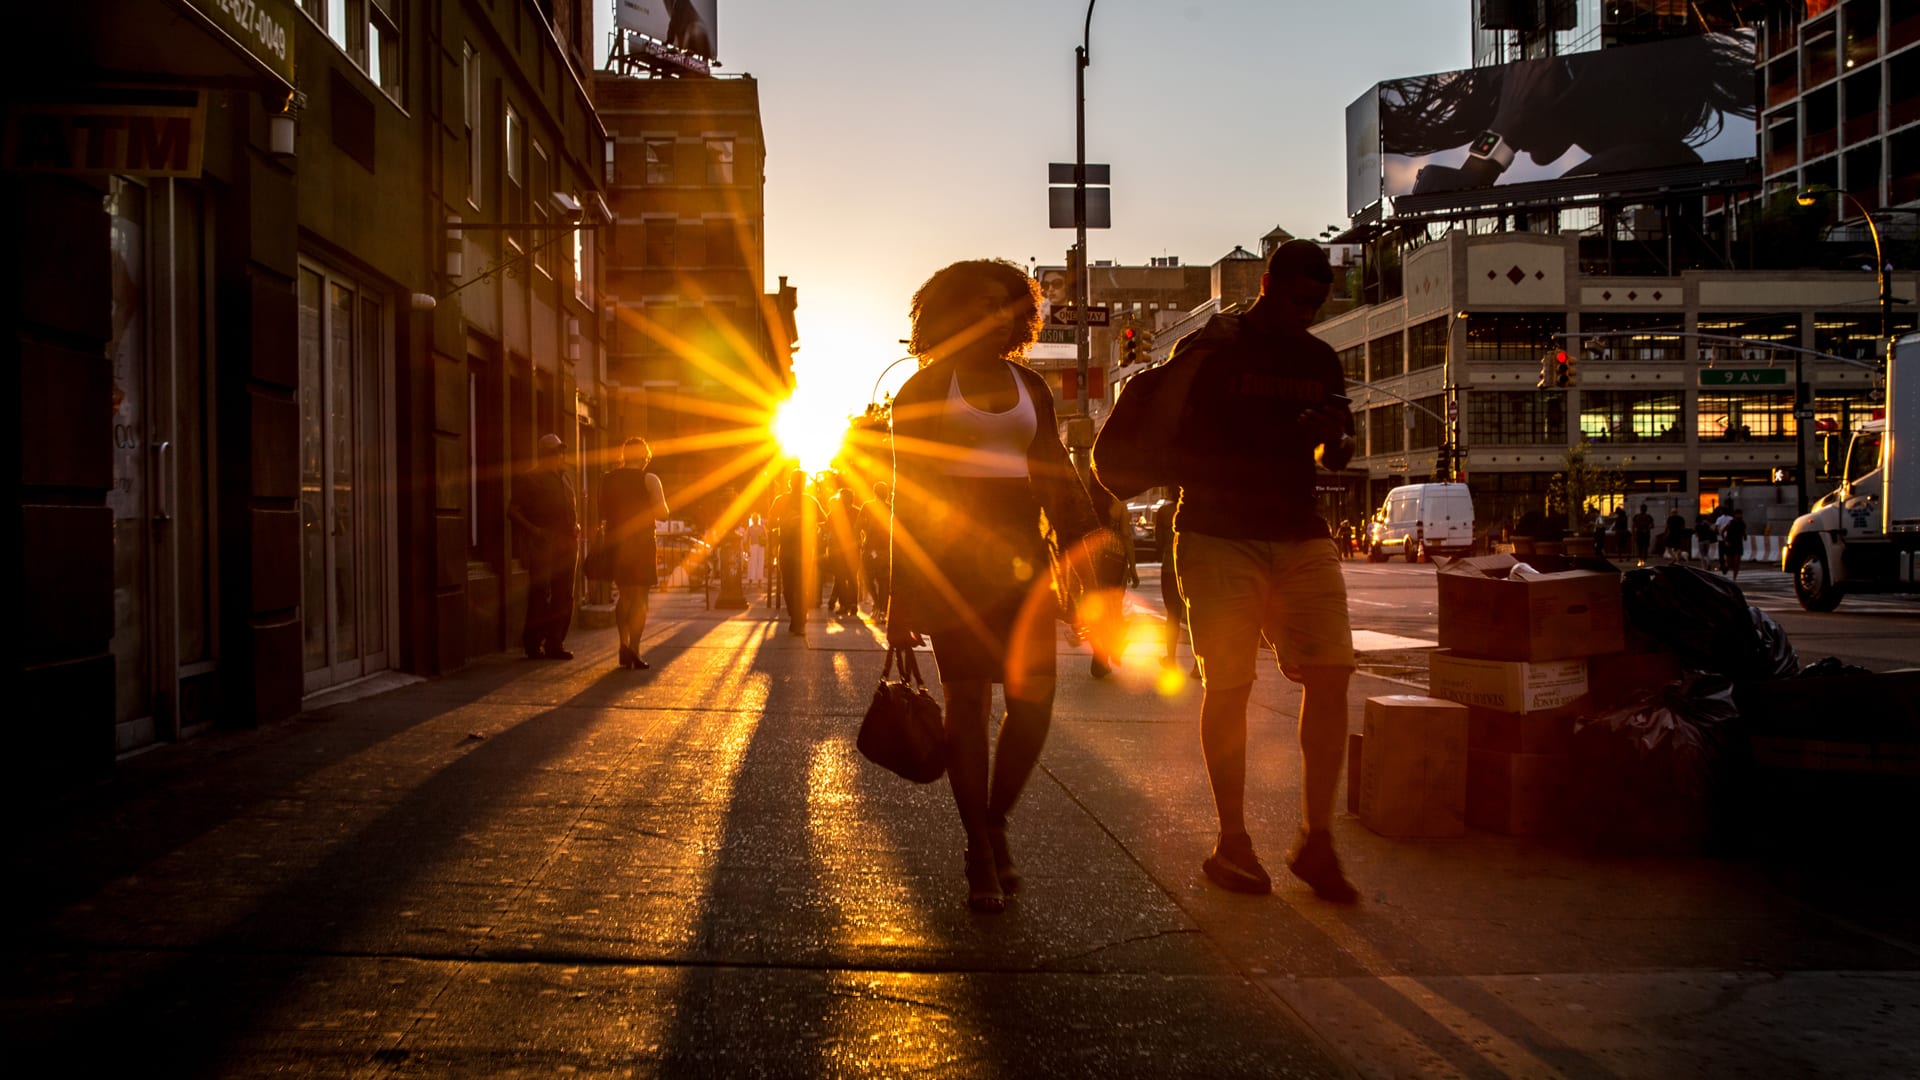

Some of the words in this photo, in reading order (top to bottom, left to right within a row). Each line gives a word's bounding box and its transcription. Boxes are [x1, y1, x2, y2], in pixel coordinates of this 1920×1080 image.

[215, 0, 287, 61] -627-0049
[15, 116, 191, 170] ATM
[1059, 310, 1077, 321] ONE
[1038, 330, 1064, 343] DSON
[1723, 371, 1735, 383] 9
[1740, 371, 1761, 383] Av
